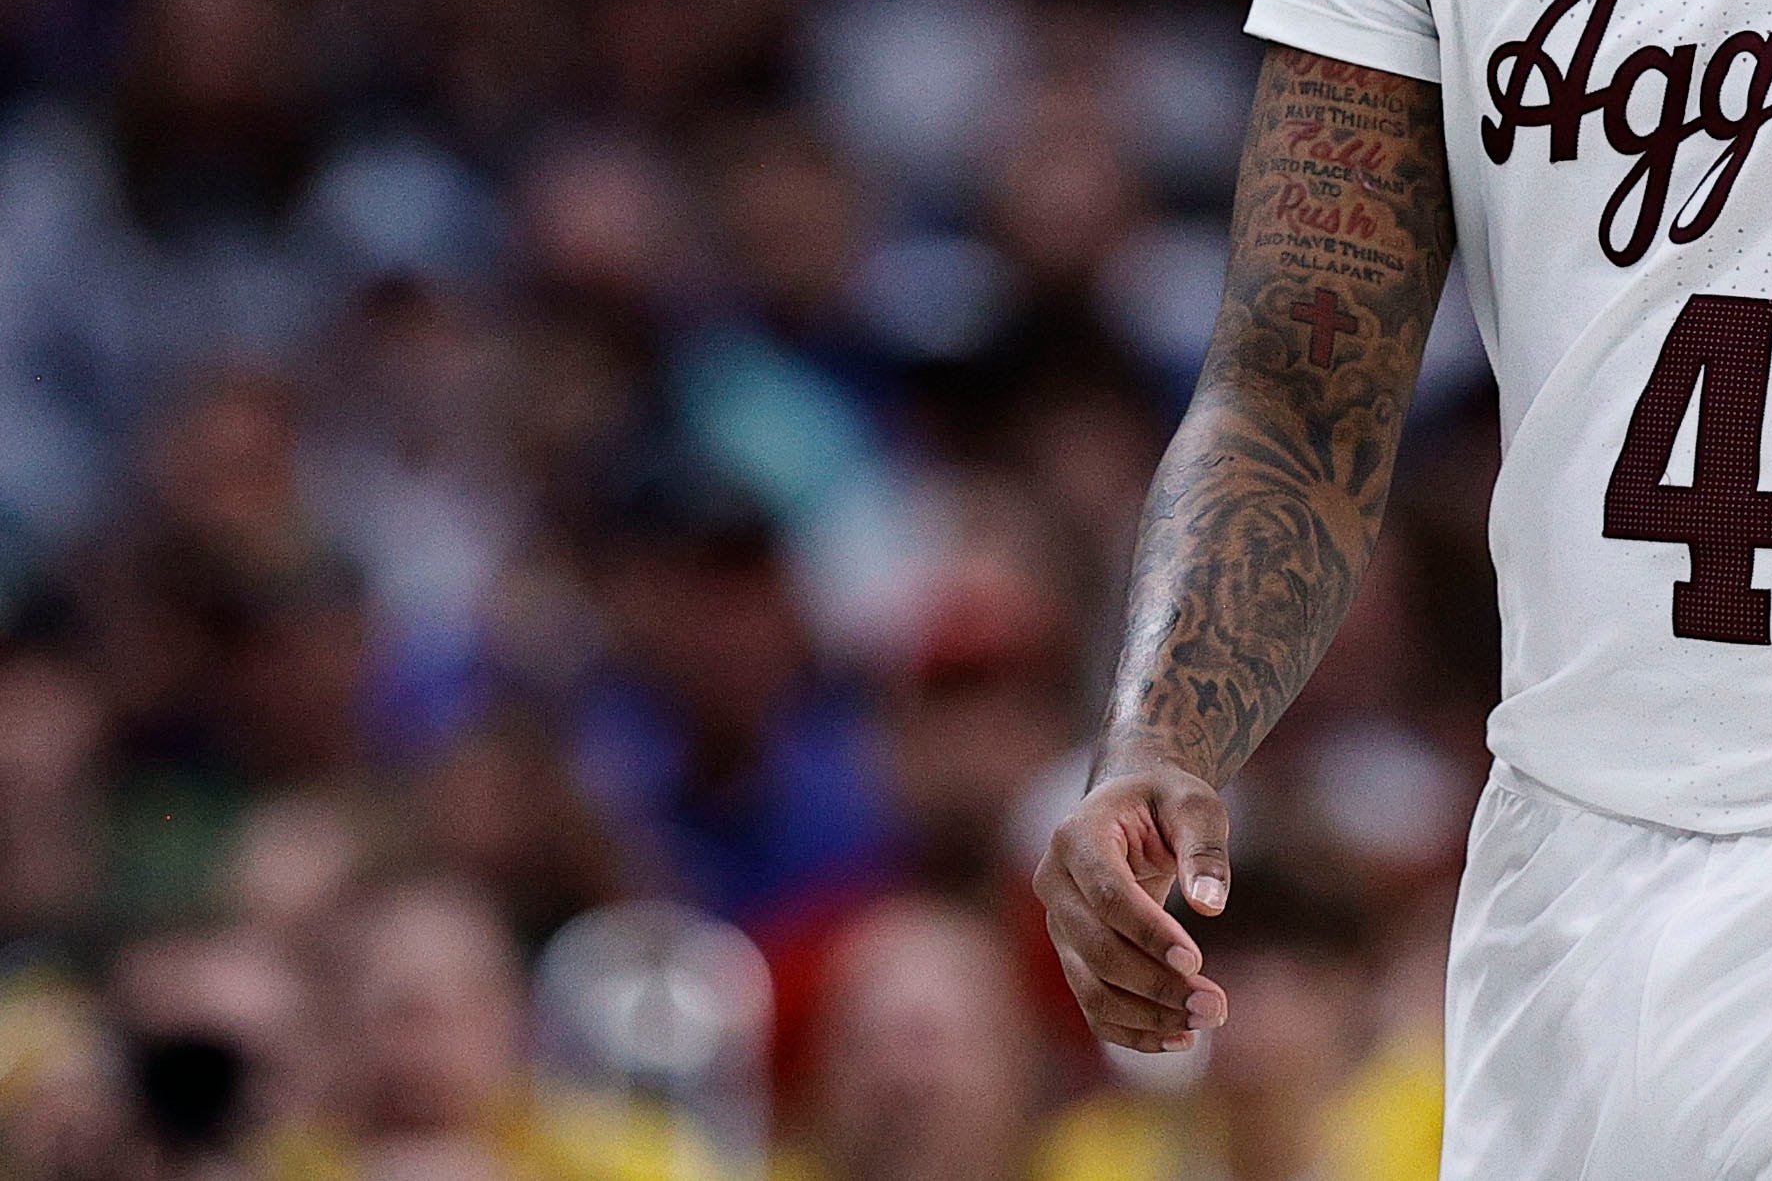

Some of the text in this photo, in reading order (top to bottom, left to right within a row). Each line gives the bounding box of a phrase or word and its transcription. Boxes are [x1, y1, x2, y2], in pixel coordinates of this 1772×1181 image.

[1298, 80, 1357, 104] WHILE
[1302, 160, 1353, 182] PLACE
[1287, 233, 1336, 253] HAVE
[1325, 259, 1385, 285] APART
